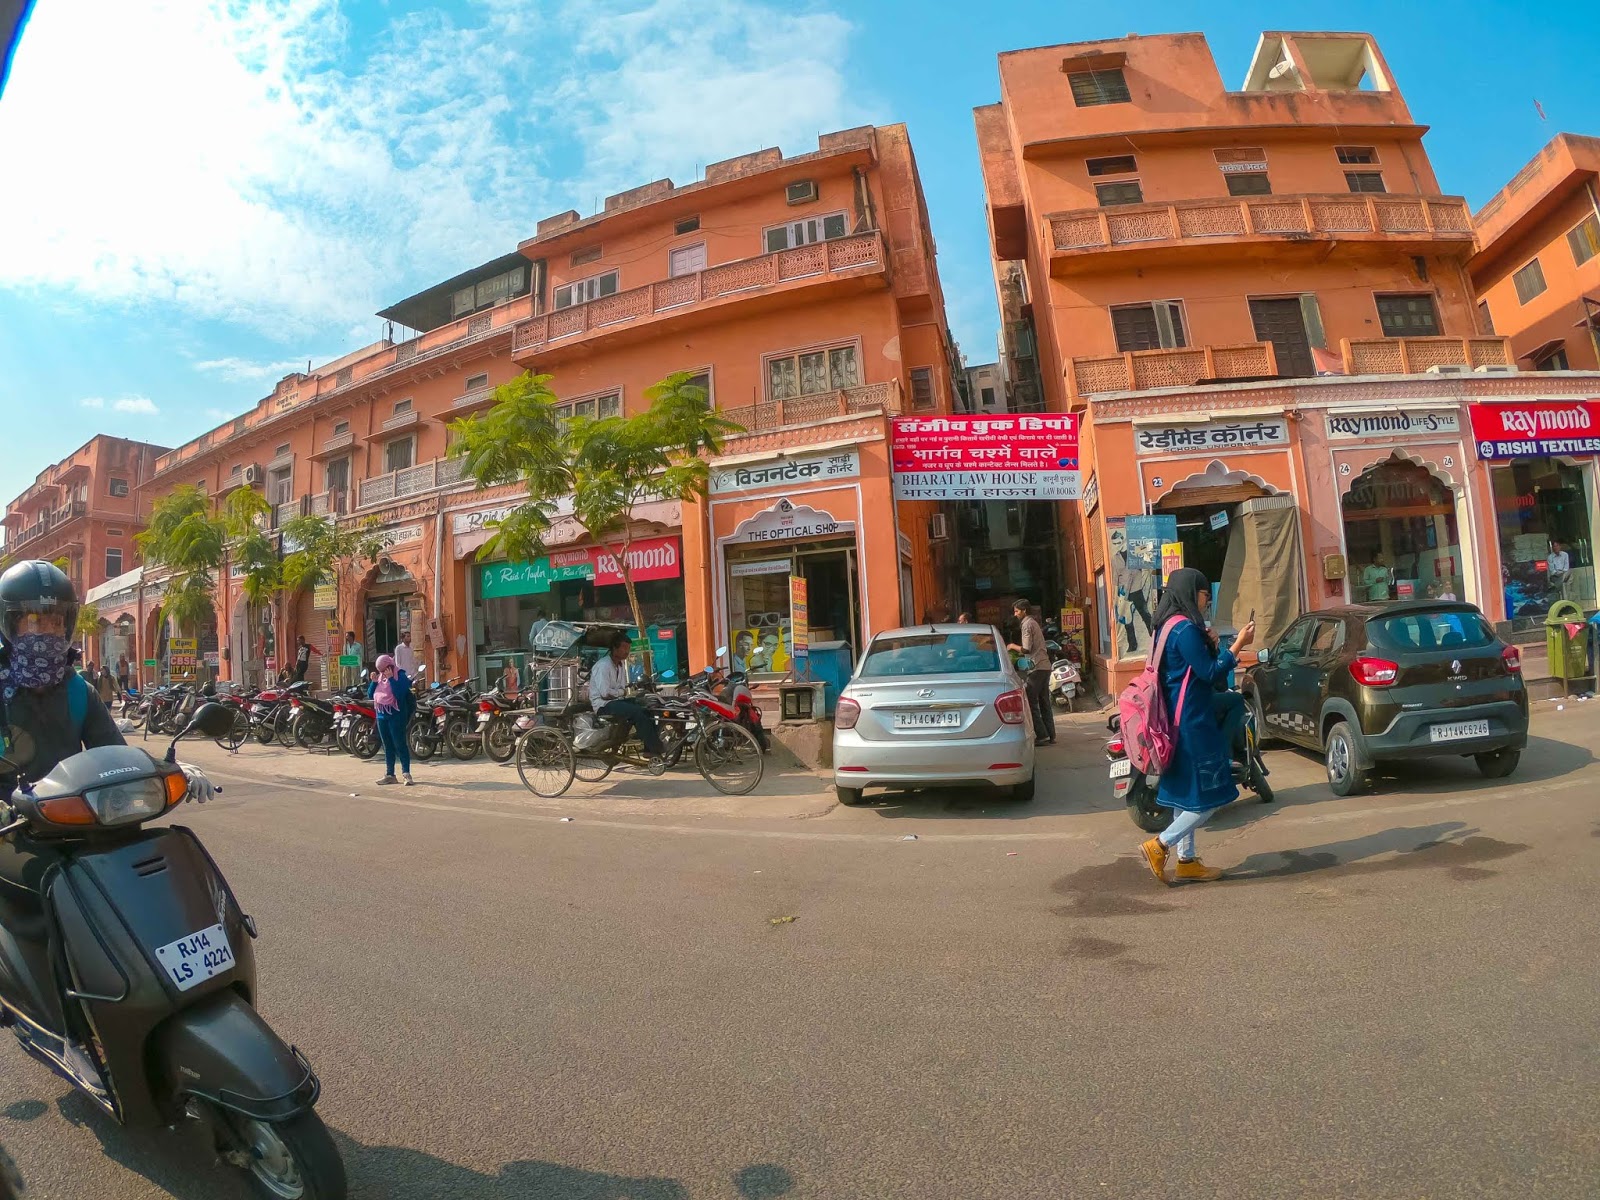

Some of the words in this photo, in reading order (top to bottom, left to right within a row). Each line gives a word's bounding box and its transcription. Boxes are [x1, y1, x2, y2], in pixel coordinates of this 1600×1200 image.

[898, 418, 968, 432] संजीव
[1019, 416, 1073, 430] डिपो
[1329, 411, 1411, 435] Raymond
[1499, 405, 1591, 437] Raymond
[1140, 428, 1208, 448] रेडीमेड
[1210, 423, 1280, 443] कॉर्नर
[912, 446, 963, 460] भार्गव
[968, 444, 1012, 459] चश्में
[1018, 444, 1057, 459] वाले
[1483, 445, 1493, 454] 25
[1497, 441, 1537, 455] RISHI
[1540, 439, 1600, 453] TEXTILES
[827, 462, 853, 475] कॉर्नर
[1340, 466, 1350, 474] 24
[1444, 458, 1453, 466] 24
[735, 461, 823, 486] विजनटैक
[902, 473, 955, 486] BHARAT
[959, 473, 988, 485] LAW
[992, 472, 1037, 485] HOUSE
[1152, 478, 1163, 487] 23
[901, 489, 947, 497] भारत
[952, 487, 976, 497] लॉ
[981, 488, 1037, 497] हाऊस
[1043, 487, 1055, 495] LAW
[1056, 487, 1076, 495] BOOKS
[467, 511, 498, 526] Reid
[748, 531, 767, 541] THE
[769, 525, 813, 539] OPTICAL
[815, 523, 839, 534] SHOP
[554, 549, 589, 565] Raymond
[597, 542, 675, 579] Raymond
[500, 567, 520, 583] Reid
[524, 565, 546, 584] Taylor
[170, 657, 196, 665] CBSE
[901, 713, 958, 725] RJ14CW2191
[1437, 723, 1488, 738] RJ14WC6246
[98, 766, 141, 779] HONDA
[177, 933, 210, 958] RJ14
[173, 962, 194, 983] LS
[203, 945, 231, 968] 4221
